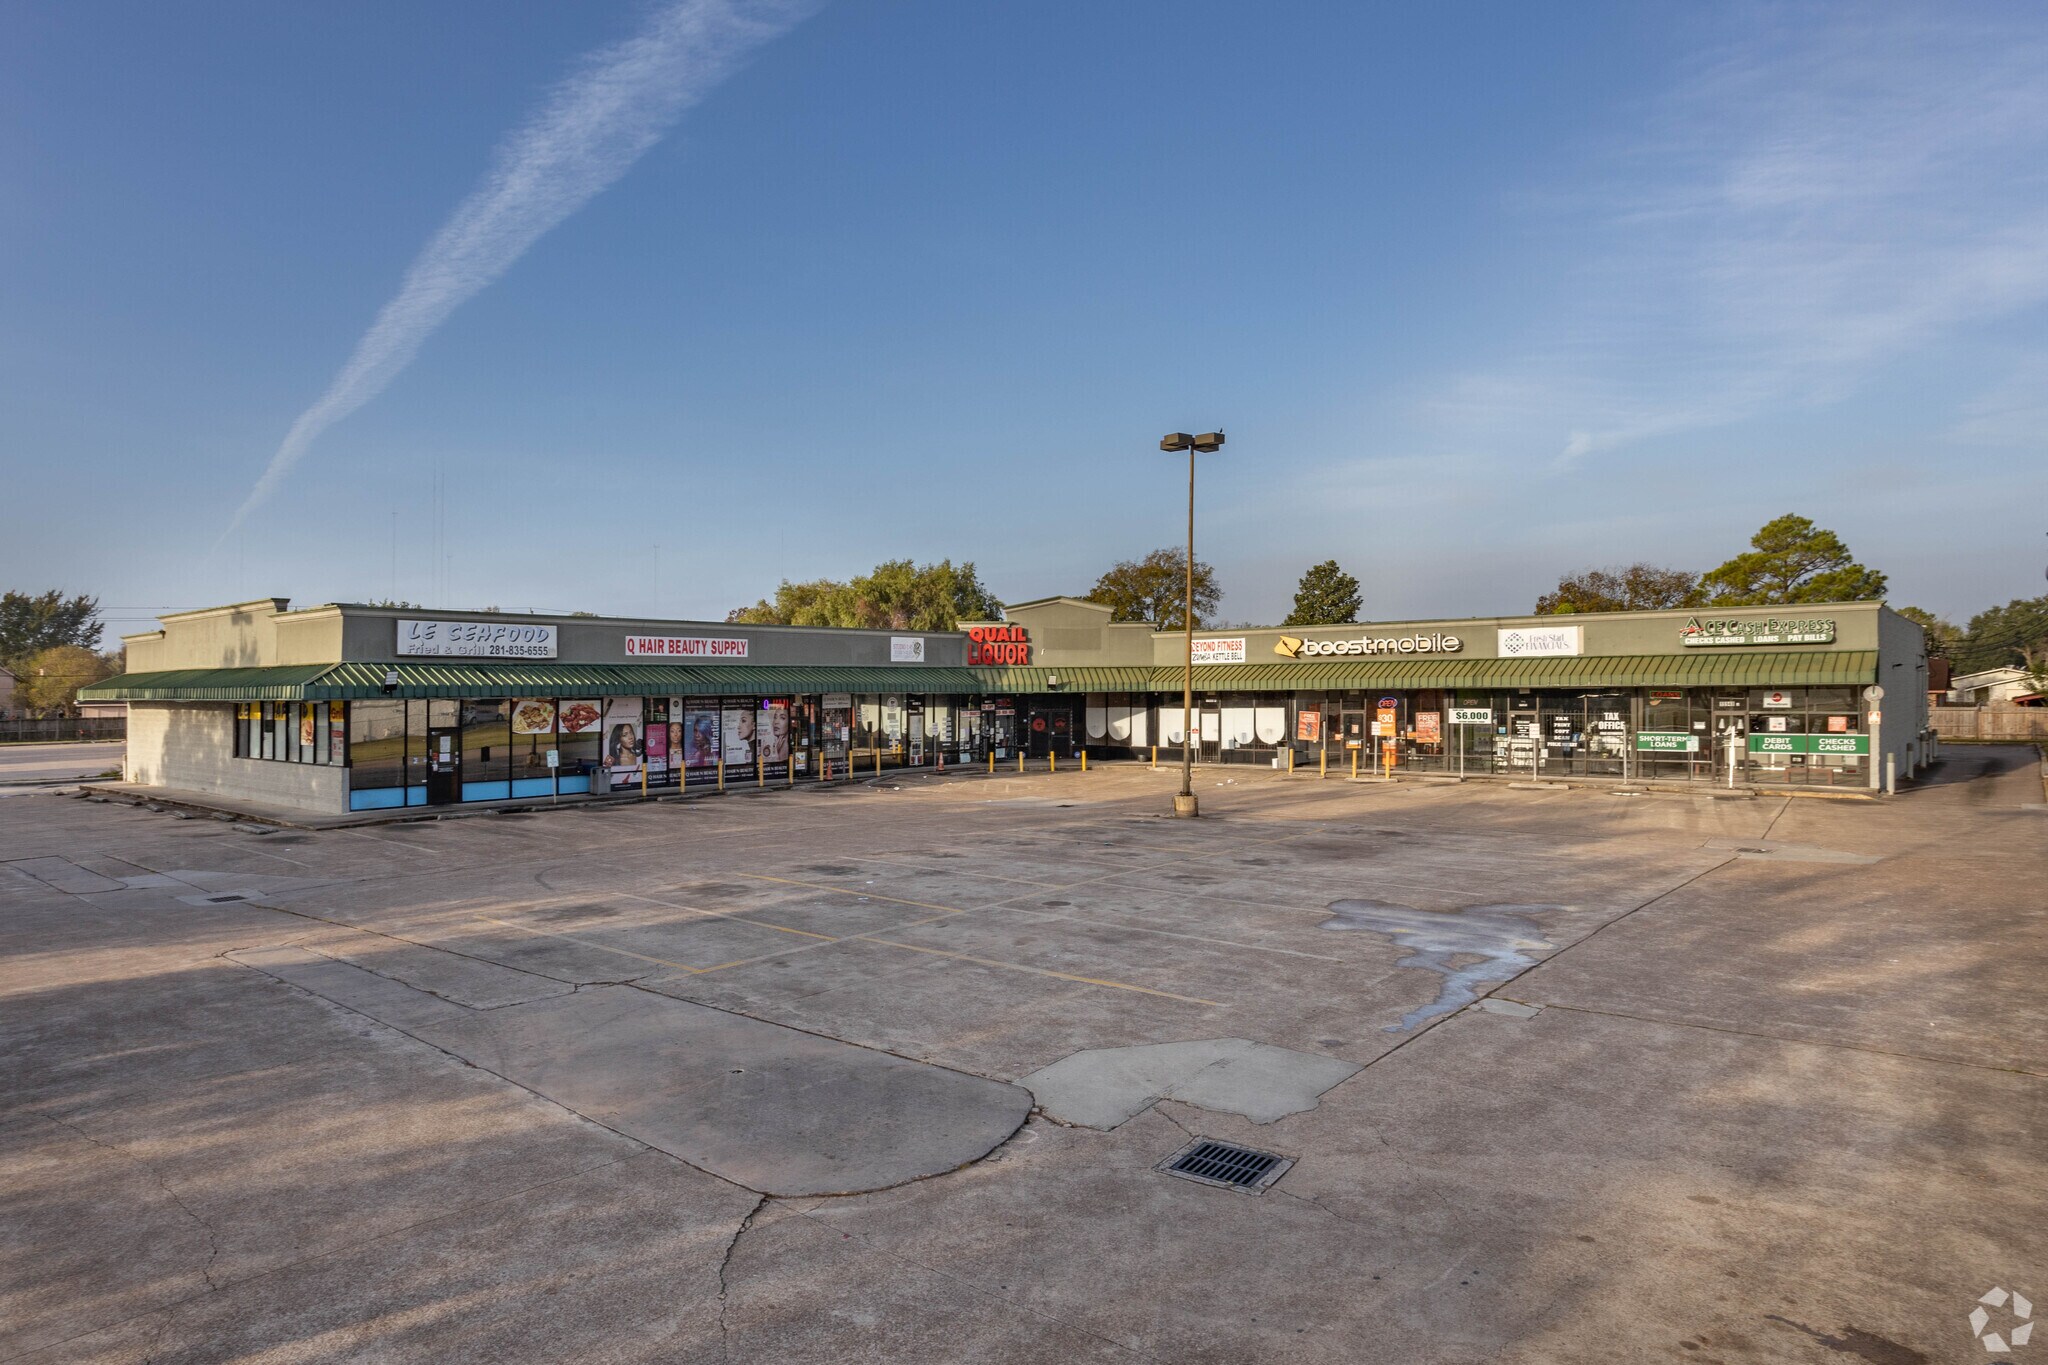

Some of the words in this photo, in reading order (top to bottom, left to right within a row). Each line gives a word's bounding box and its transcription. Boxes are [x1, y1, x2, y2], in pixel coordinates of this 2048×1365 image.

[408, 622, 437, 640] LE
[450, 623, 549, 643] SEAFOOD
[1680, 616, 1723, 636] ACE
[1727, 619, 1765, 635] CASH
[1767, 618, 1834, 633] EXPRESS
[969, 627, 1027, 643] QUAIL
[1685, 636, 1714, 644] CHECKS
[1715, 636, 1745, 644] CASHED
[1753, 635, 1779, 643] LOANS
[1787, 634, 1803, 642] PAY
[1804, 633, 1827, 641] BILLS
[407, 642, 439, 654] Fried
[458, 643, 485, 656] Grill
[489, 645, 548, 656] 281-835-6555
[627, 638, 635, 655] Q
[639, 638, 665, 654] HAIR
[668, 639, 707, 655] BEAUTY
[711, 640, 746, 655] SUPPLY
[1217, 640, 1243, 651] FITNESS
[967, 643, 1028, 666] LIQUOR
[1212, 652, 1230, 661] KETTLE
[1231, 652, 1243, 660] BELL
[1603, 712, 1620, 721] TAX
[1598, 721, 1625, 730] OFFICE
